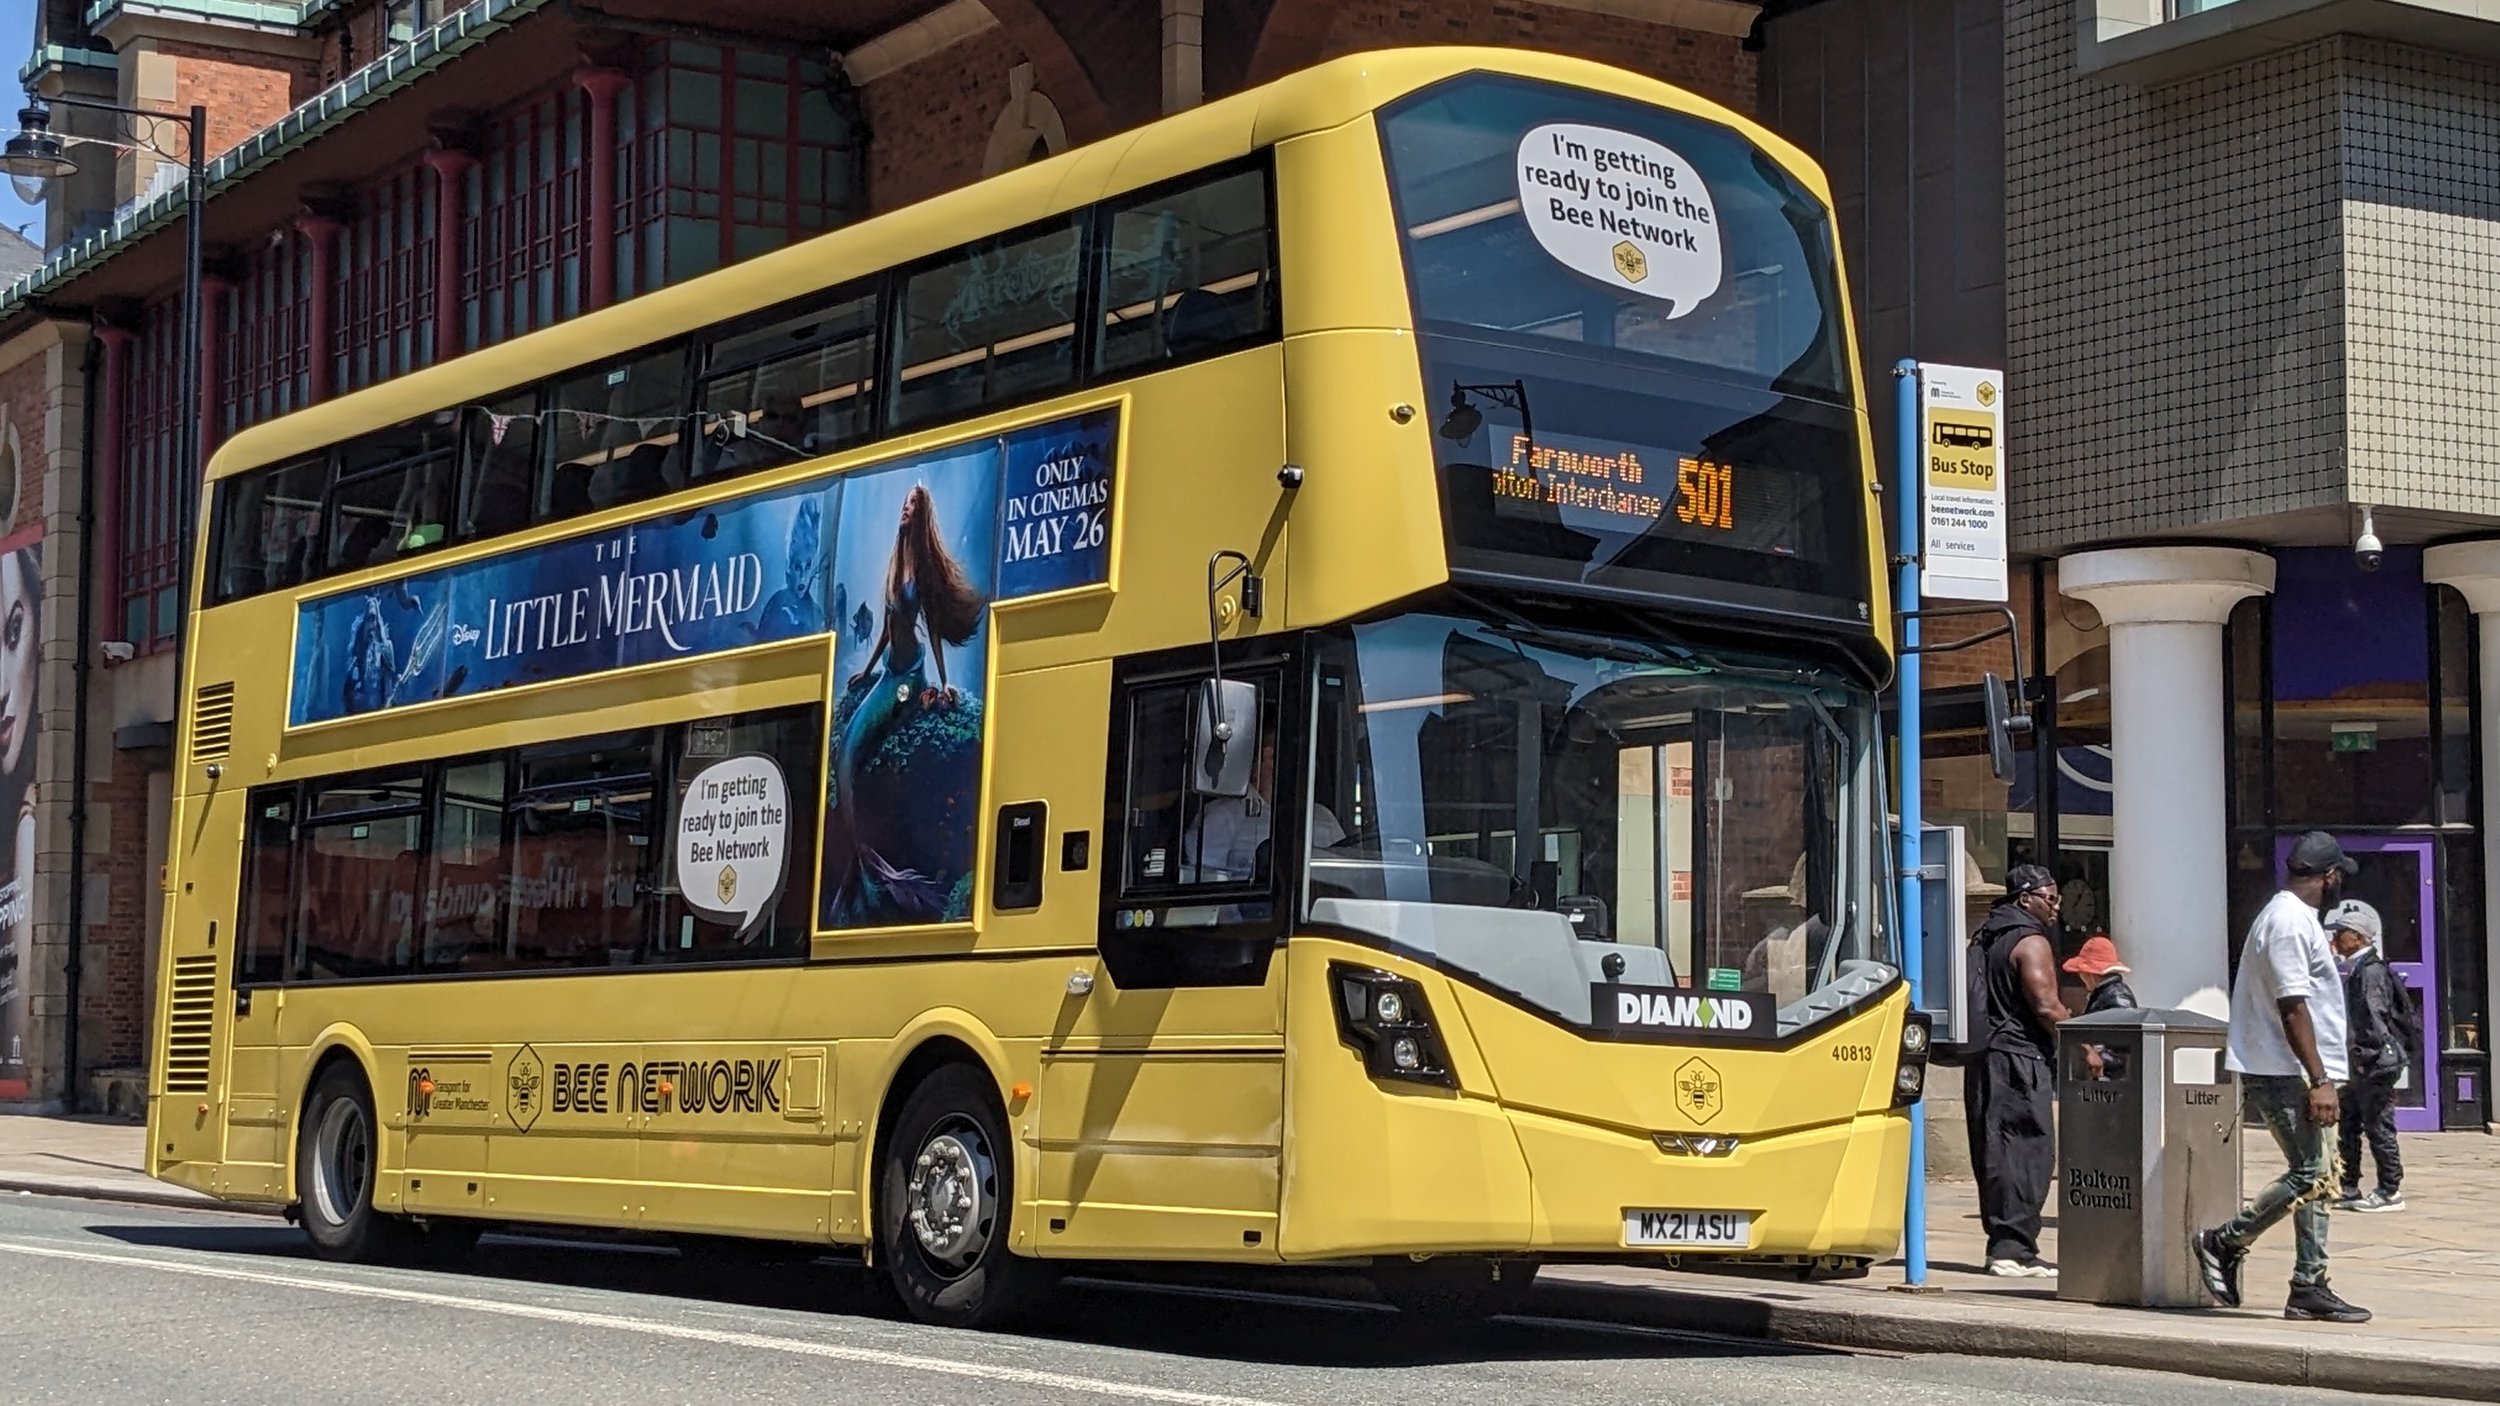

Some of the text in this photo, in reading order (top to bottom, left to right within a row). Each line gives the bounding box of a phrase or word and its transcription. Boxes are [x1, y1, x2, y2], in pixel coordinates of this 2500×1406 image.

[1552, 133, 1677, 190] I'm getting
[1525, 165, 1710, 224] ready to join the
[1550, 198, 1698, 253] Bee Network
[1035, 456, 1084, 487] ONLY
[1512, 434, 1643, 484] Farnworth
[1931, 456, 1994, 481] Bus Stop
[1007, 479, 1108, 522] IN CINEMAS
[1546, 472, 1662, 520] Interchange
[1676, 457, 1734, 530] 501
[1931, 503, 1995, 517] beenetwork.com
[1931, 516, 1988, 529] 0161 244 1000
[595, 535, 637, 563] THE
[1004, 508, 1106, 563] MAY 26
[1931, 539, 1975, 551] All services
[485, 552, 762, 661] LITTLE MERMAID
[701, 774, 767, 804] I'm getting
[683, 804, 783, 837] ready to join the
[690, 836, 770, 863] Bee Network
[1832, 1045, 1872, 1062] 40813
[552, 1058, 782, 1115] BEE NETWORK
[2082, 1087, 2118, 1103] Litter
[2185, 1089, 2220, 1105] Litter
[2069, 1168, 2130, 1191] Bolton
[2069, 1189, 2132, 1210] Council
[1640, 1213, 1737, 1241] MX21 ASU
